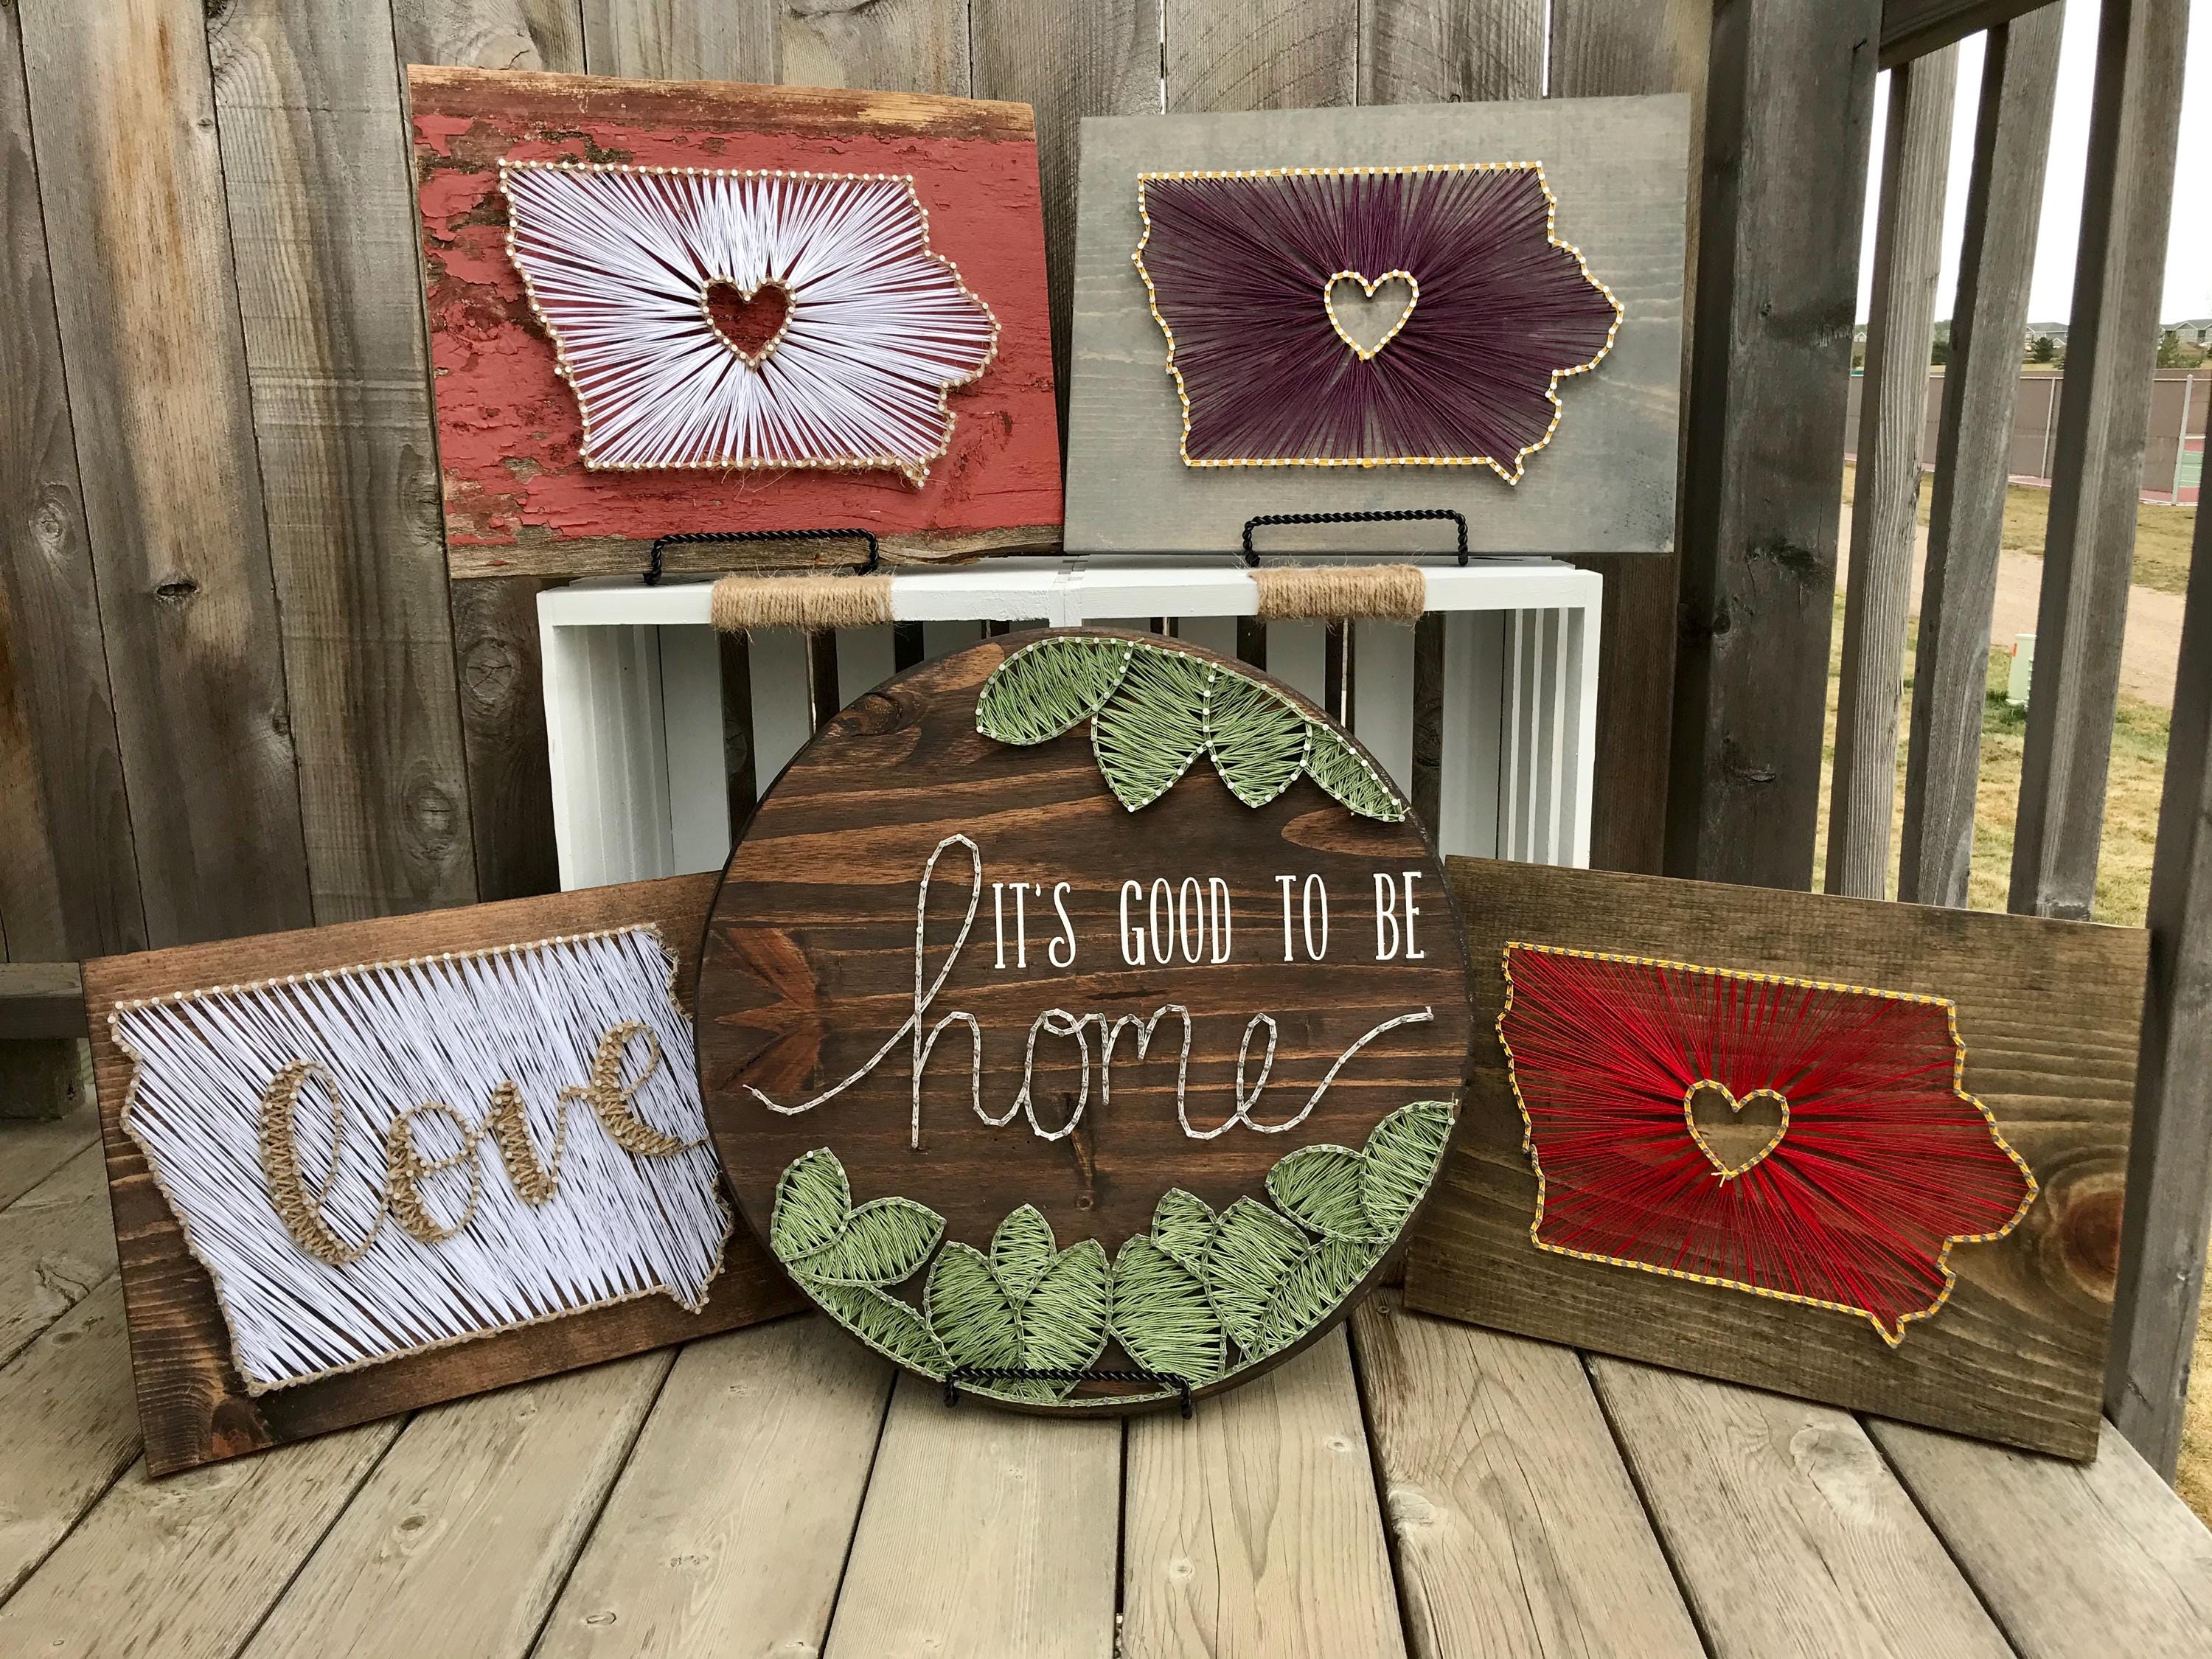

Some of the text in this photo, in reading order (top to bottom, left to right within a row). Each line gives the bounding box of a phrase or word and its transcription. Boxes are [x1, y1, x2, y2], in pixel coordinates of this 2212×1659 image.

[742, 833, 1433, 1150] home
[992, 871, 1425, 970] IT'S GOOD TO BE
[260, 1019, 709, 1265] love
